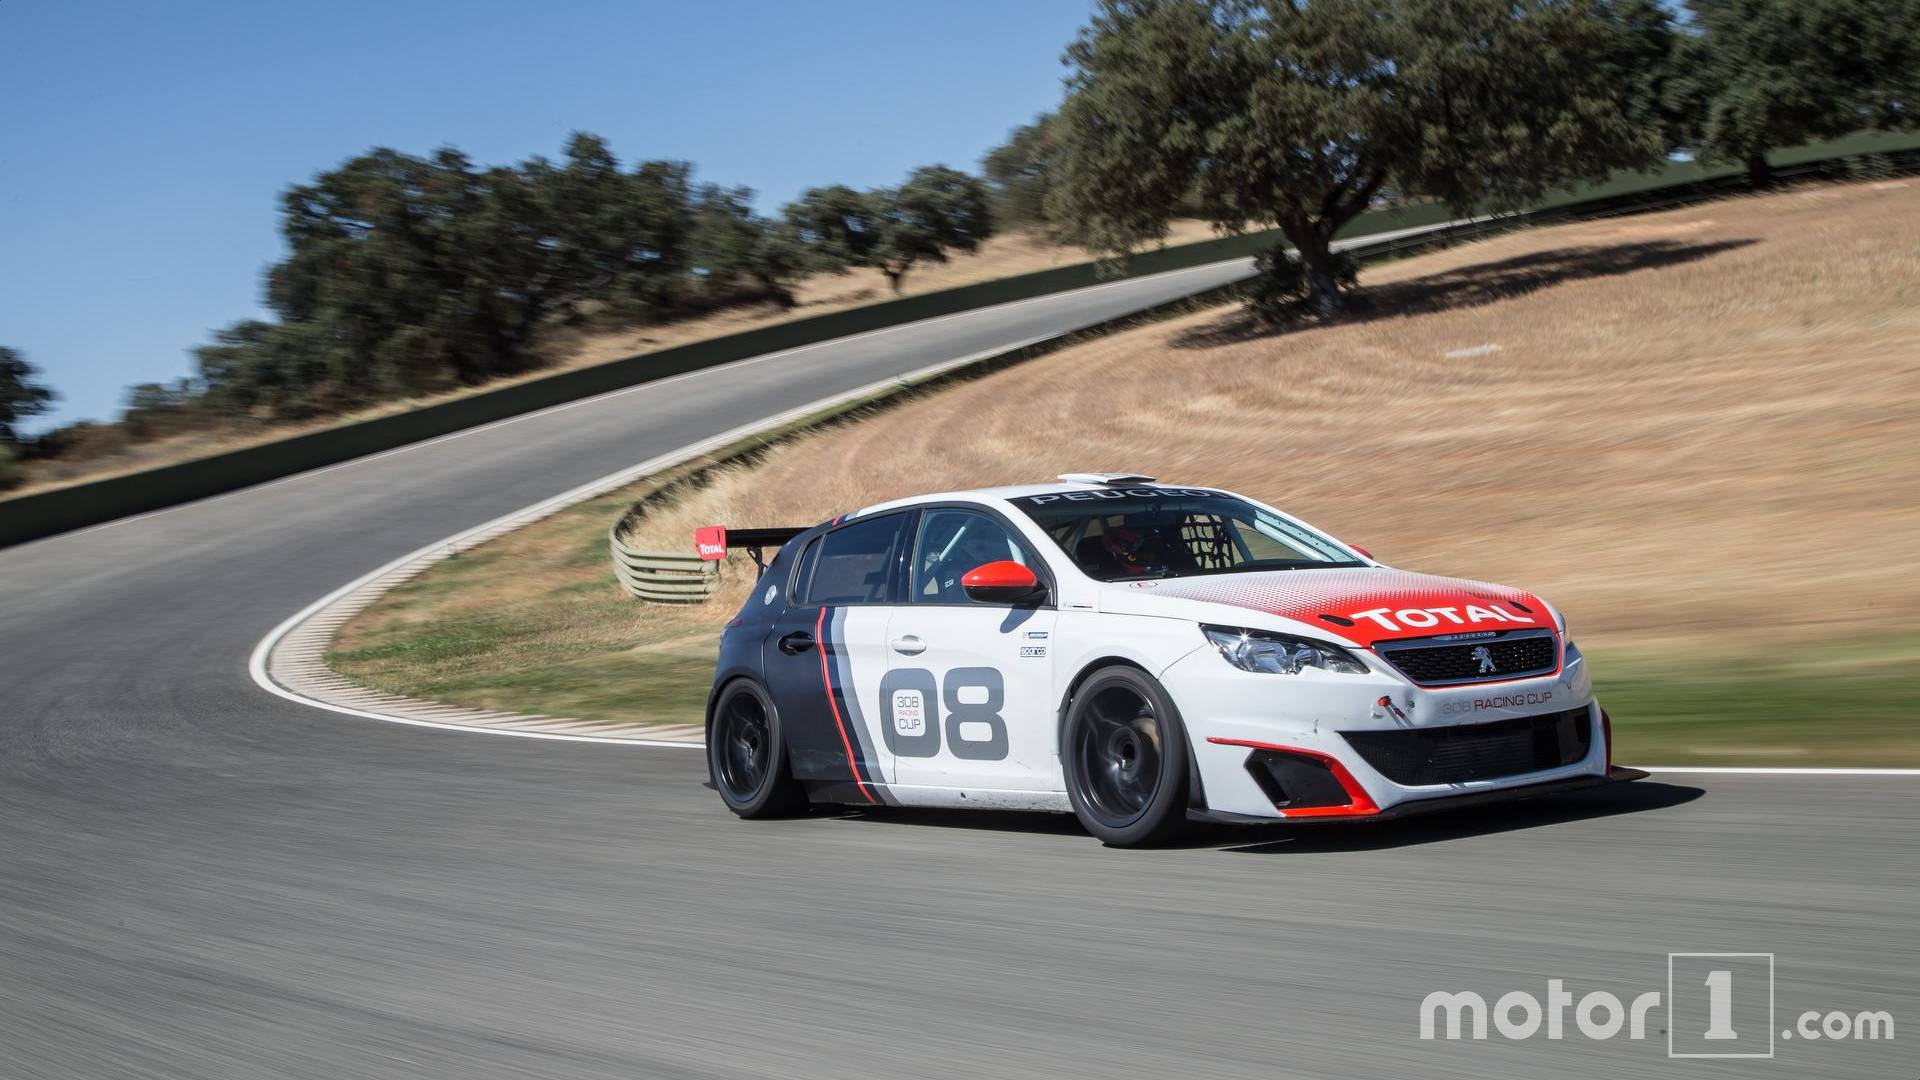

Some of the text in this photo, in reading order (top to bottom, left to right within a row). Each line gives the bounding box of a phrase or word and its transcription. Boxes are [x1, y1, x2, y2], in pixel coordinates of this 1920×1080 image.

[699, 544, 725, 555] TOTAL
[1350, 604, 1536, 632] TOTAL
[896, 696, 920, 708] 308
[1473, 694, 1525, 712] RACING
[1527, 691, 1553, 705] CUP
[878, 666, 1010, 762] 08
[899, 718, 921, 730] CUP
